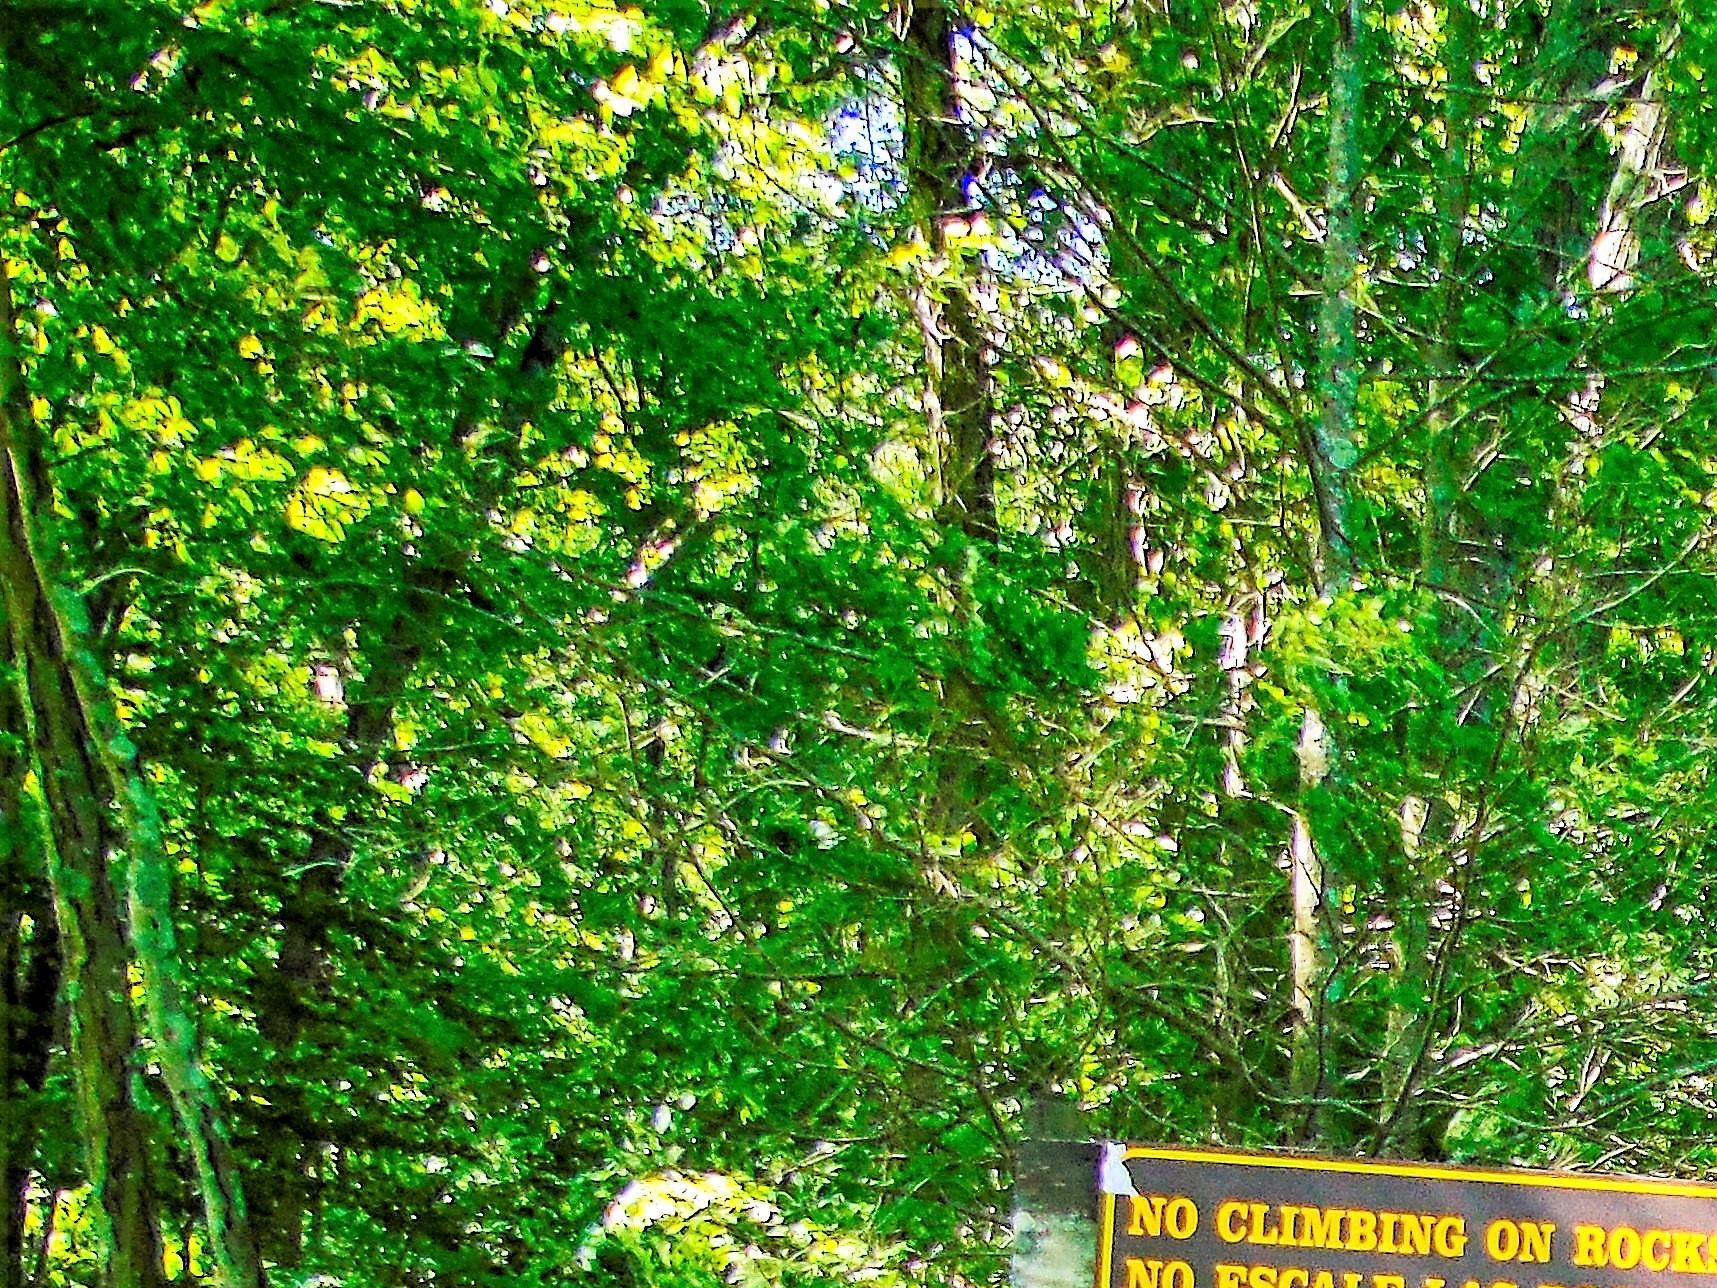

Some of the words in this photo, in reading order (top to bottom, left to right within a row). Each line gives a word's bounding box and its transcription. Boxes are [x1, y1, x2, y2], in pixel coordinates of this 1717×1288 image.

[1128, 1195, 1199, 1239] NO
[1216, 1200, 1468, 1258] CLIMBING
[1486, 1217, 1553, 1264] ON
